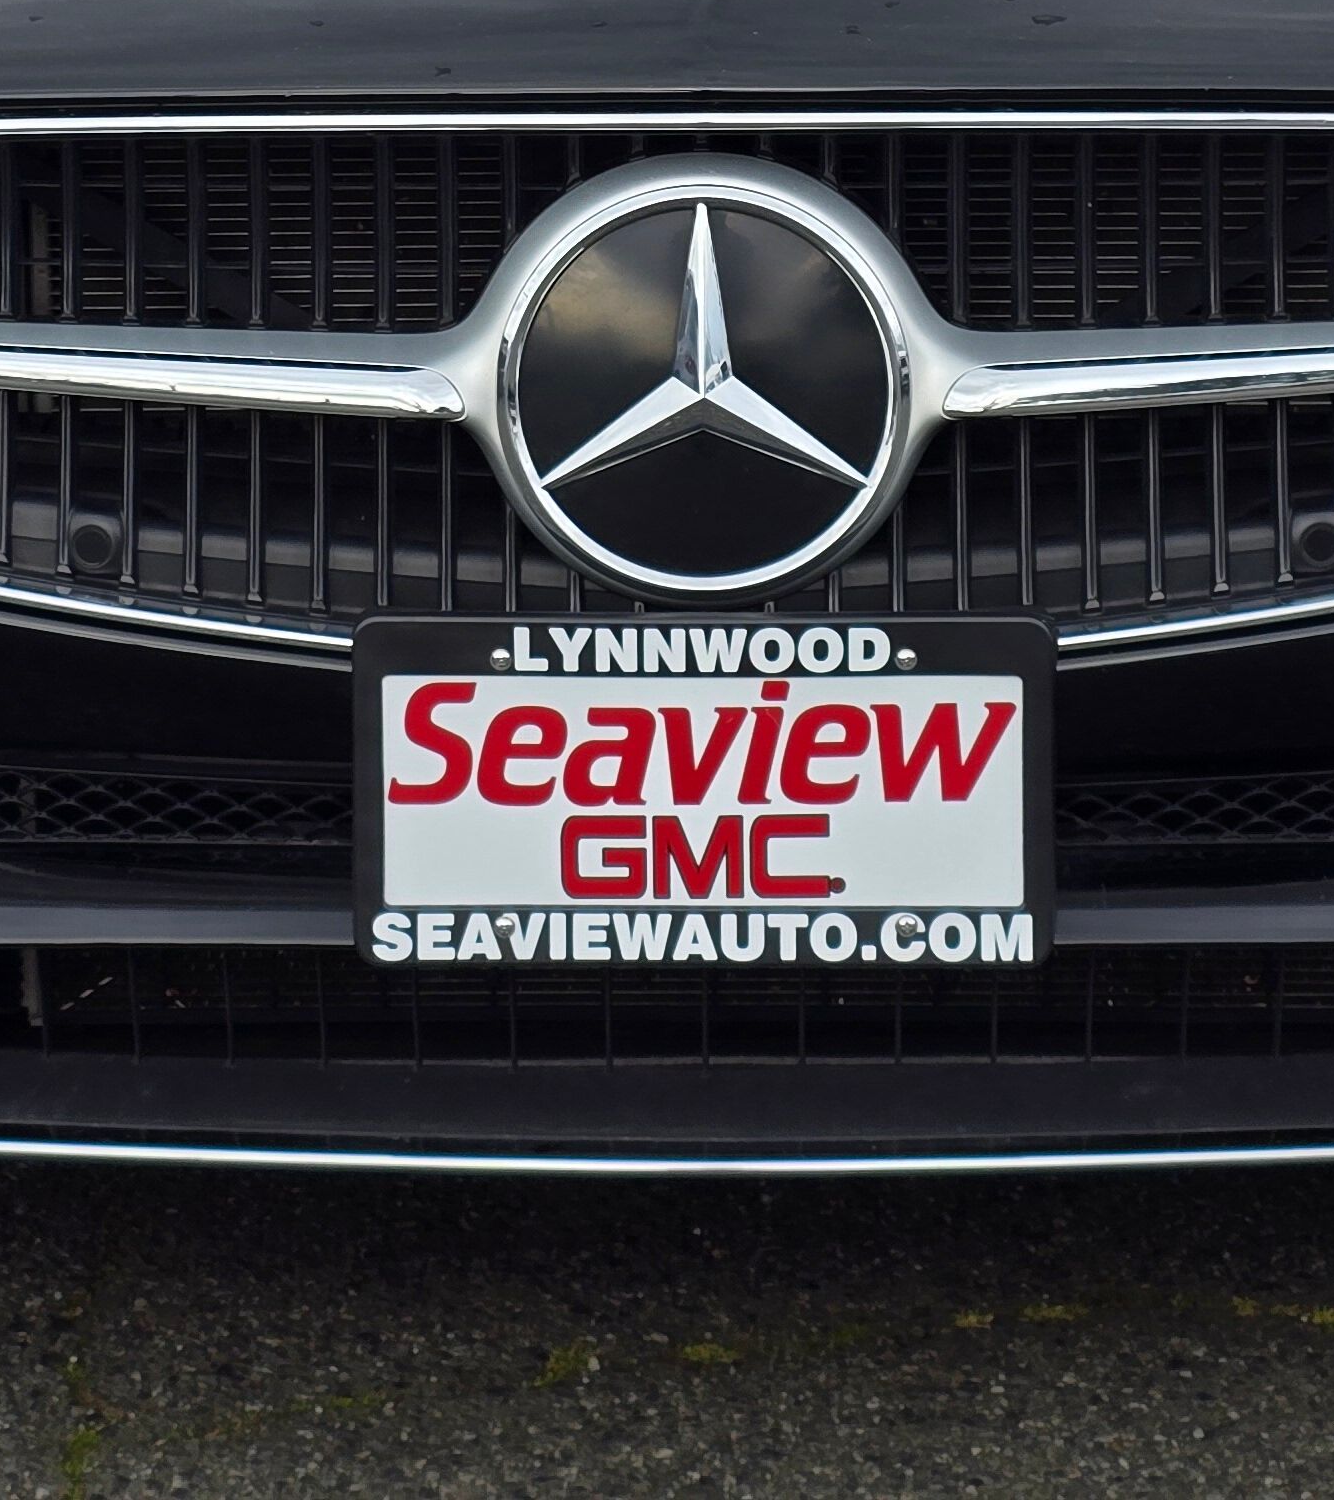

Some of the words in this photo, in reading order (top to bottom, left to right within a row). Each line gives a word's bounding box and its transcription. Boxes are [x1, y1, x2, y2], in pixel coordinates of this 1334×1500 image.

[513, 626, 891, 674] LYNNWOOD
[387, 680, 1017, 807] Seaview
[559, 813, 837, 899] GMC
[371, 911, 1034, 963] SEAVIEWAUTO.COM
